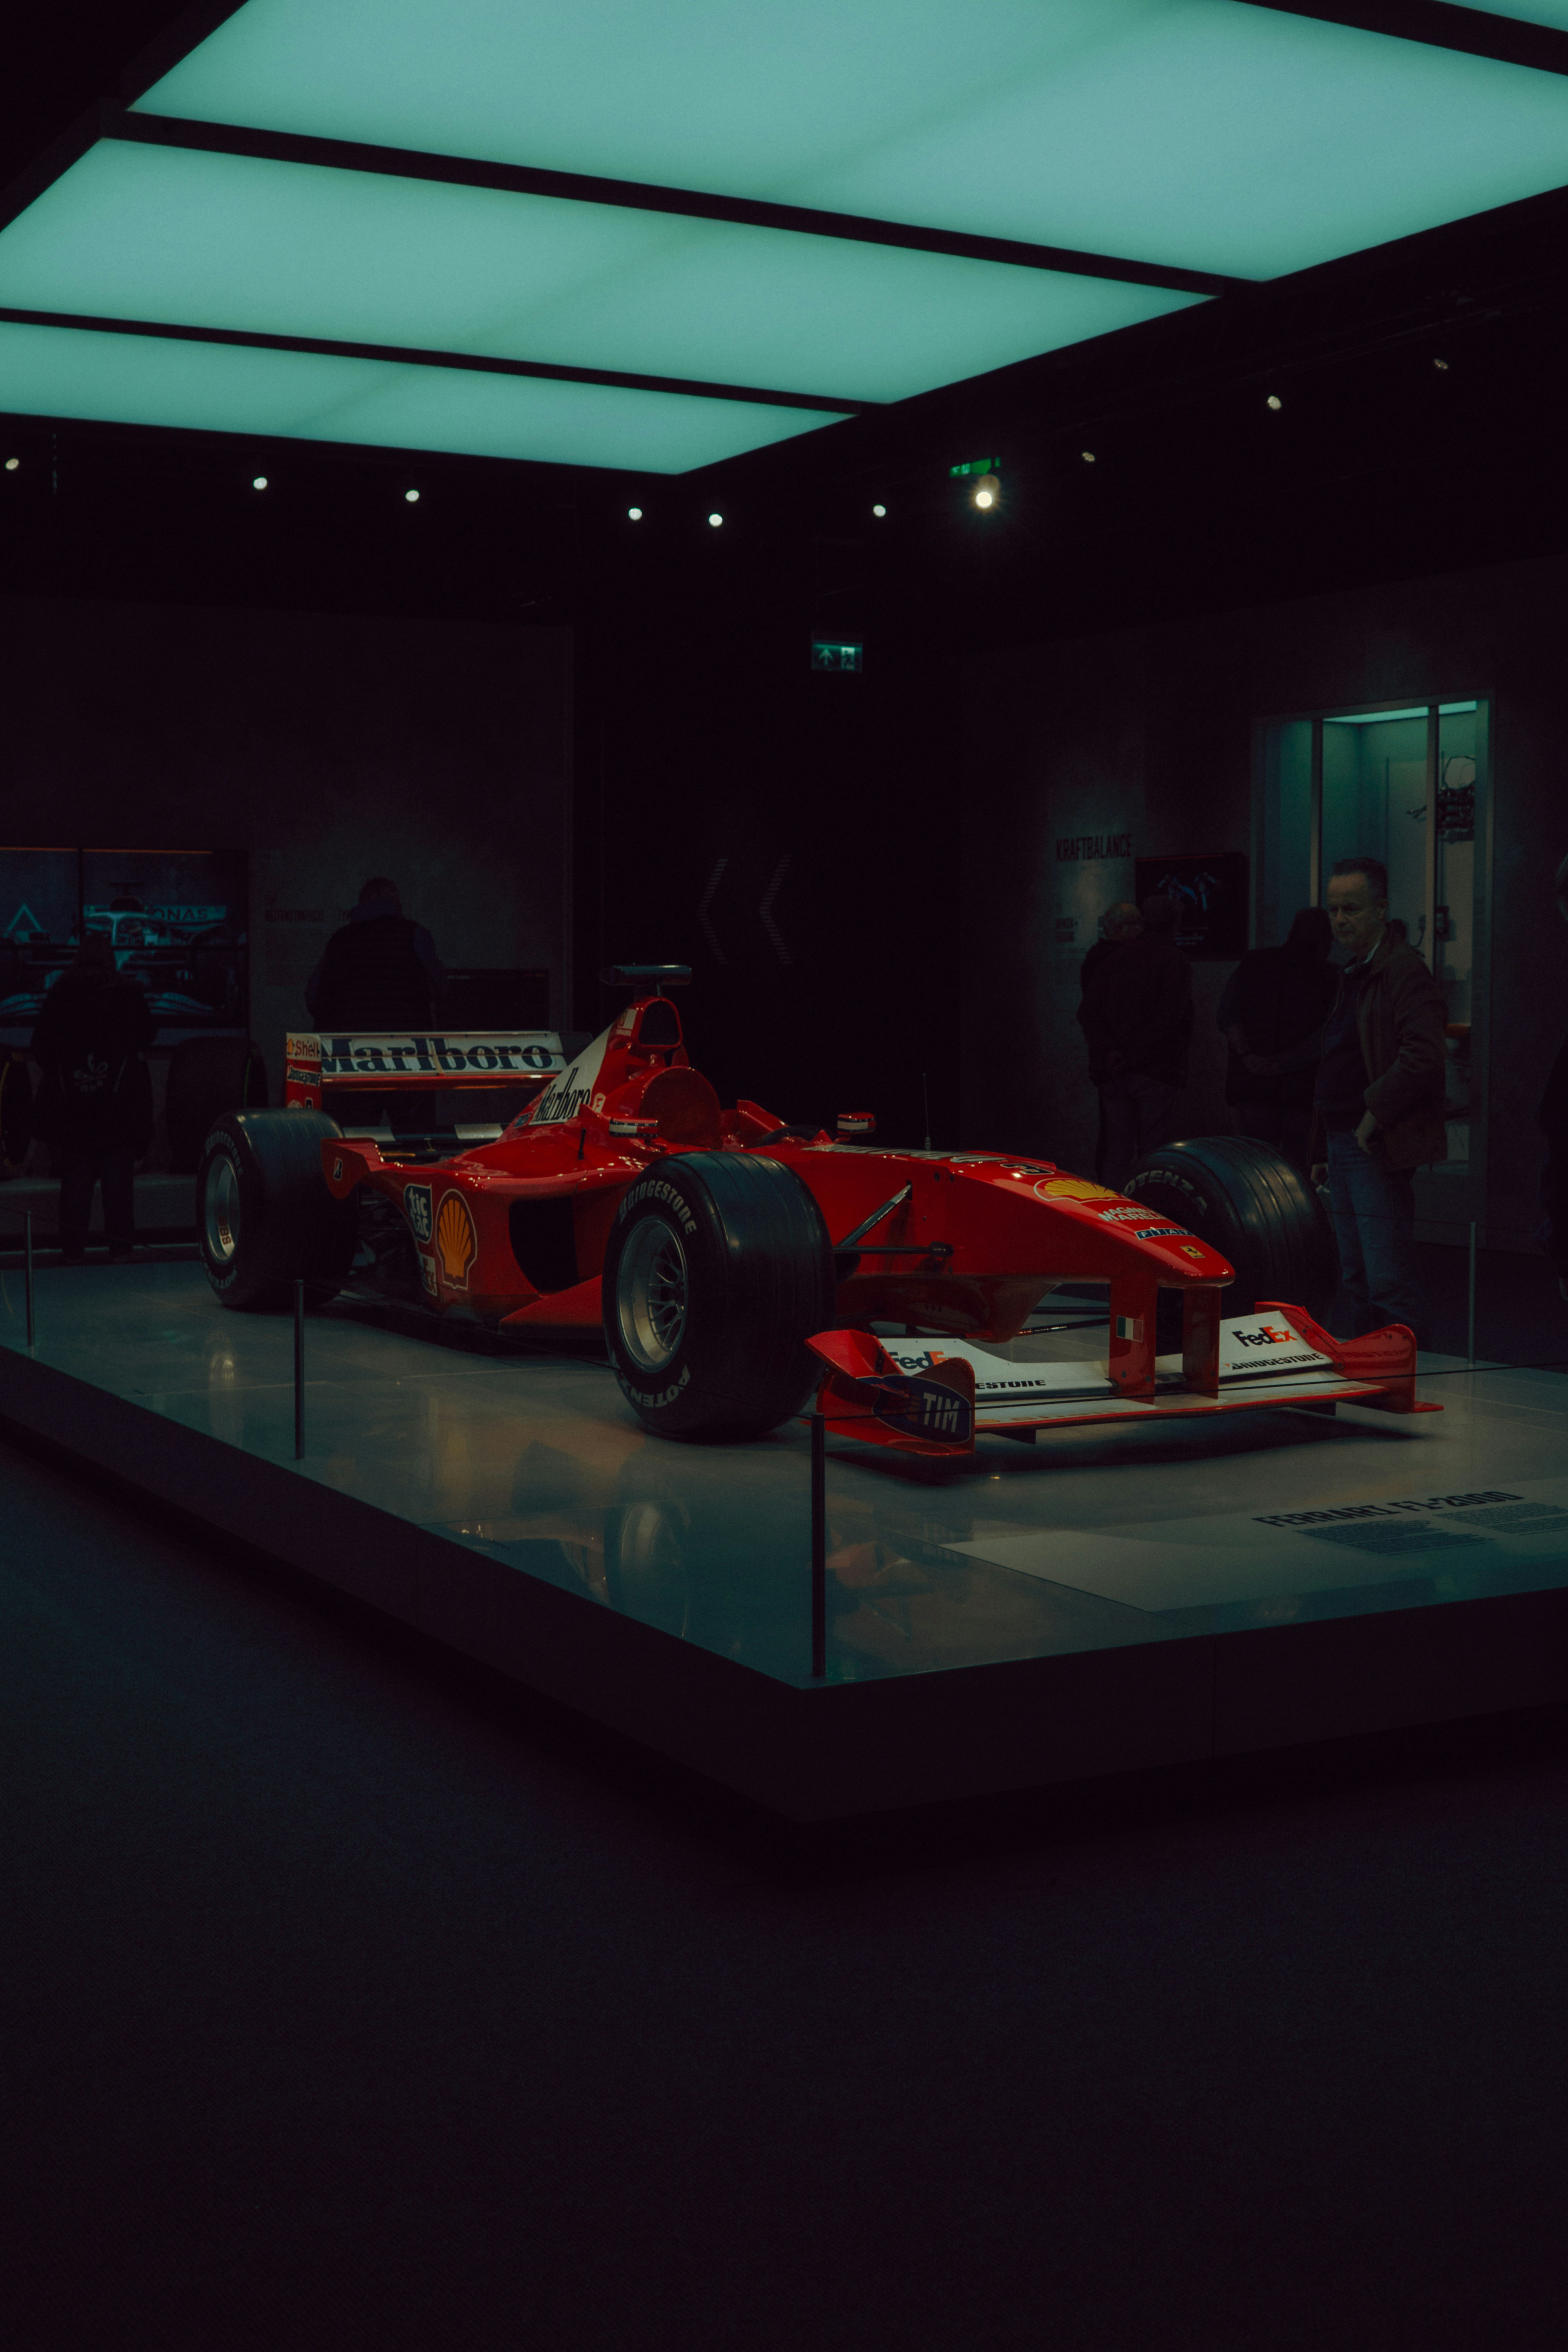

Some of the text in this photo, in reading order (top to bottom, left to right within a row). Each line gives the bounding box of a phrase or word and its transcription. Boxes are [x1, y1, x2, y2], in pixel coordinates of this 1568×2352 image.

[1056, 833, 1132, 862] KRAFTBALANCE
[296, 1040, 319, 1057] Shell
[321, 1038, 553, 1072] Marlboro
[409, 1187, 427, 1216] tic
[619, 1180, 697, 1234] BRIDGESTONE
[1122, 1170, 1207, 1216] OTENZA
[410, 1206, 429, 1237] tac
[1139, 1229, 1190, 1238] FIAT
[1232, 1326, 1298, 1347] FedEx
[888, 1351, 948, 1369] FedE
[1228, 1353, 1324, 1370] BRIDGESTONE
[975, 1379, 1046, 1390] ESTONE
[923, 1392, 960, 1433] TIM
[1250, 1491, 1525, 1527] FERRARI F1-2000
